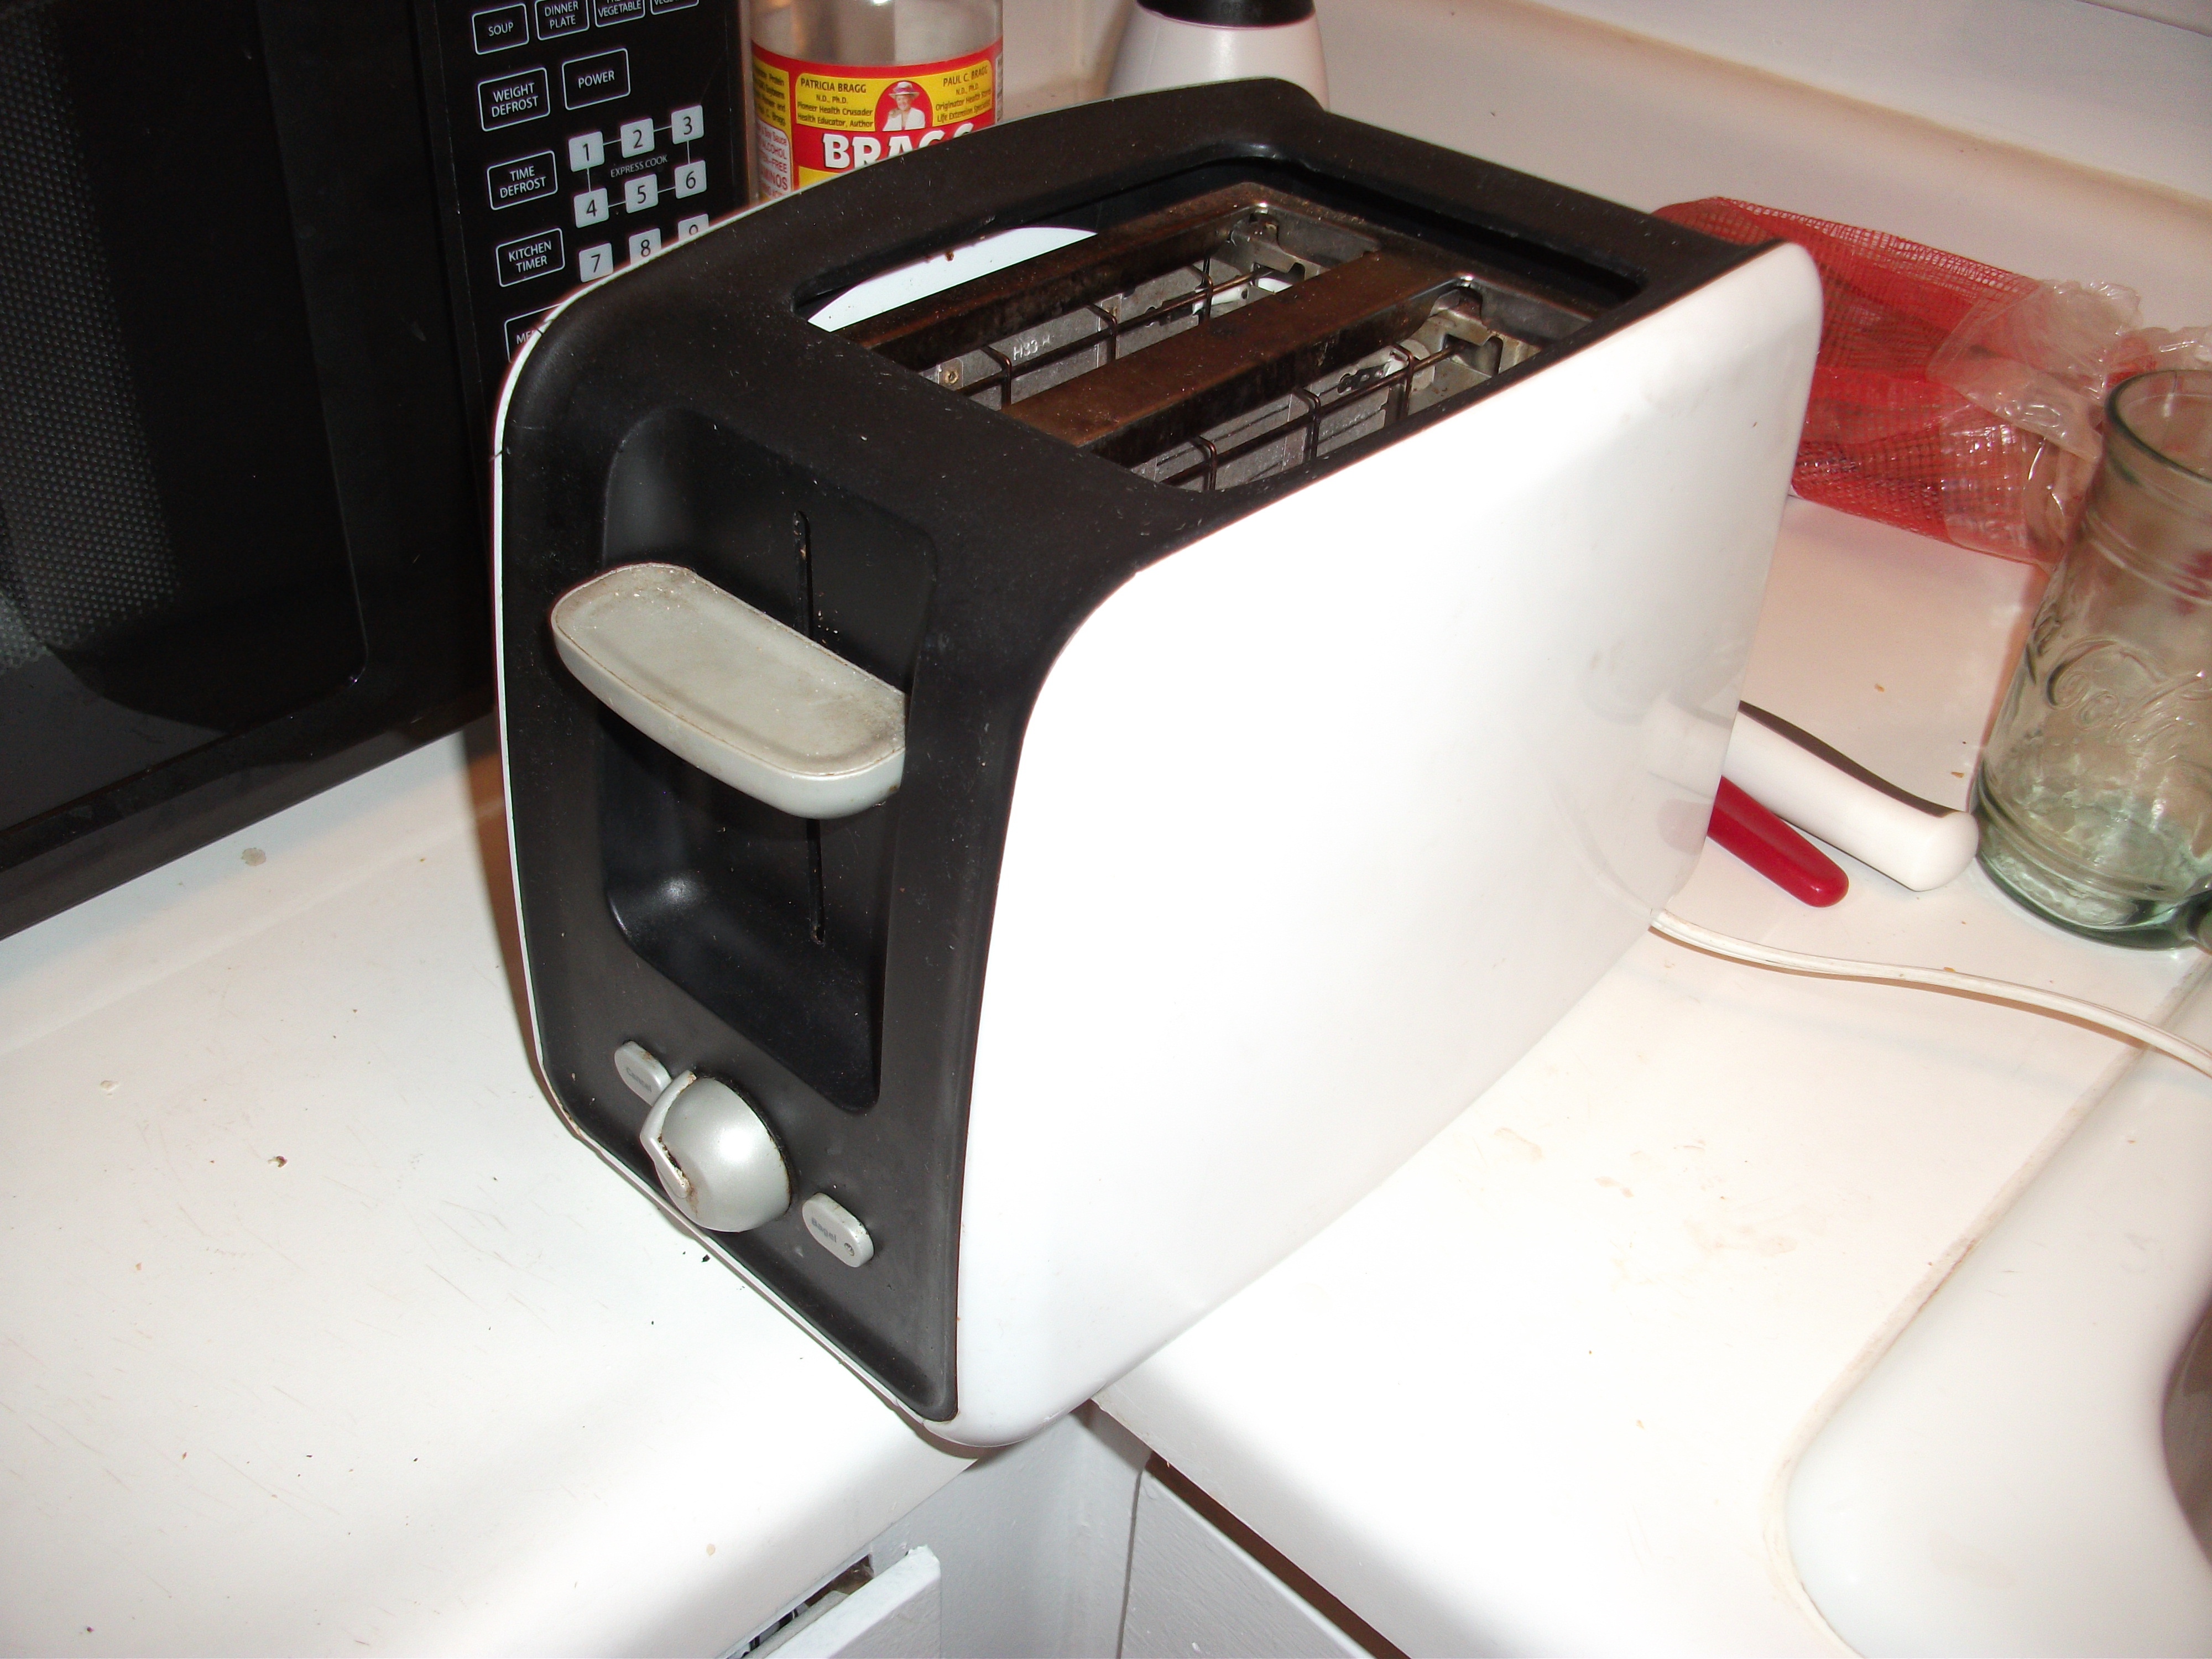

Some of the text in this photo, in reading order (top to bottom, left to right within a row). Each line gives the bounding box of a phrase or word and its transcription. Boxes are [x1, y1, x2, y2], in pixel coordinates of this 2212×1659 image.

[544, 1, 579, 17] DINNER
[598, 1, 642, 18] VEGETABLE
[488, 22, 514, 36] SOUP
[549, 15, 576, 30] PLATE
[578, 70, 615, 88] POWER
[800, 77, 867, 93] PATRICIA BRAGG
[943, 75, 961, 87] PAUL
[493, 82, 535, 103] WEIGHT
[491, 96, 539, 118] DEFROST
[797, 101, 874, 116] Pioneer Health Crusader
[935, 99, 965, 112] Originator
[682, 116, 693, 135] 3
[797, 113, 816, 122] Health
[633, 129, 644, 149] 2
[582, 143, 590, 162] 1
[509, 165, 535, 182] TIME
[611, 154, 669, 178] EXPRESS COOK
[499, 176, 546, 199] DEFROST
[685, 170, 697, 190] 6
[637, 184, 647, 204] 5
[586, 199, 597, 217] 4
[508, 239, 552, 263] KITCHEN
[640, 239, 651, 258] 8
[515, 255, 548, 273] TIMER
[590, 253, 601, 273] 7
[811, 1217, 837, 1244] Bagel
